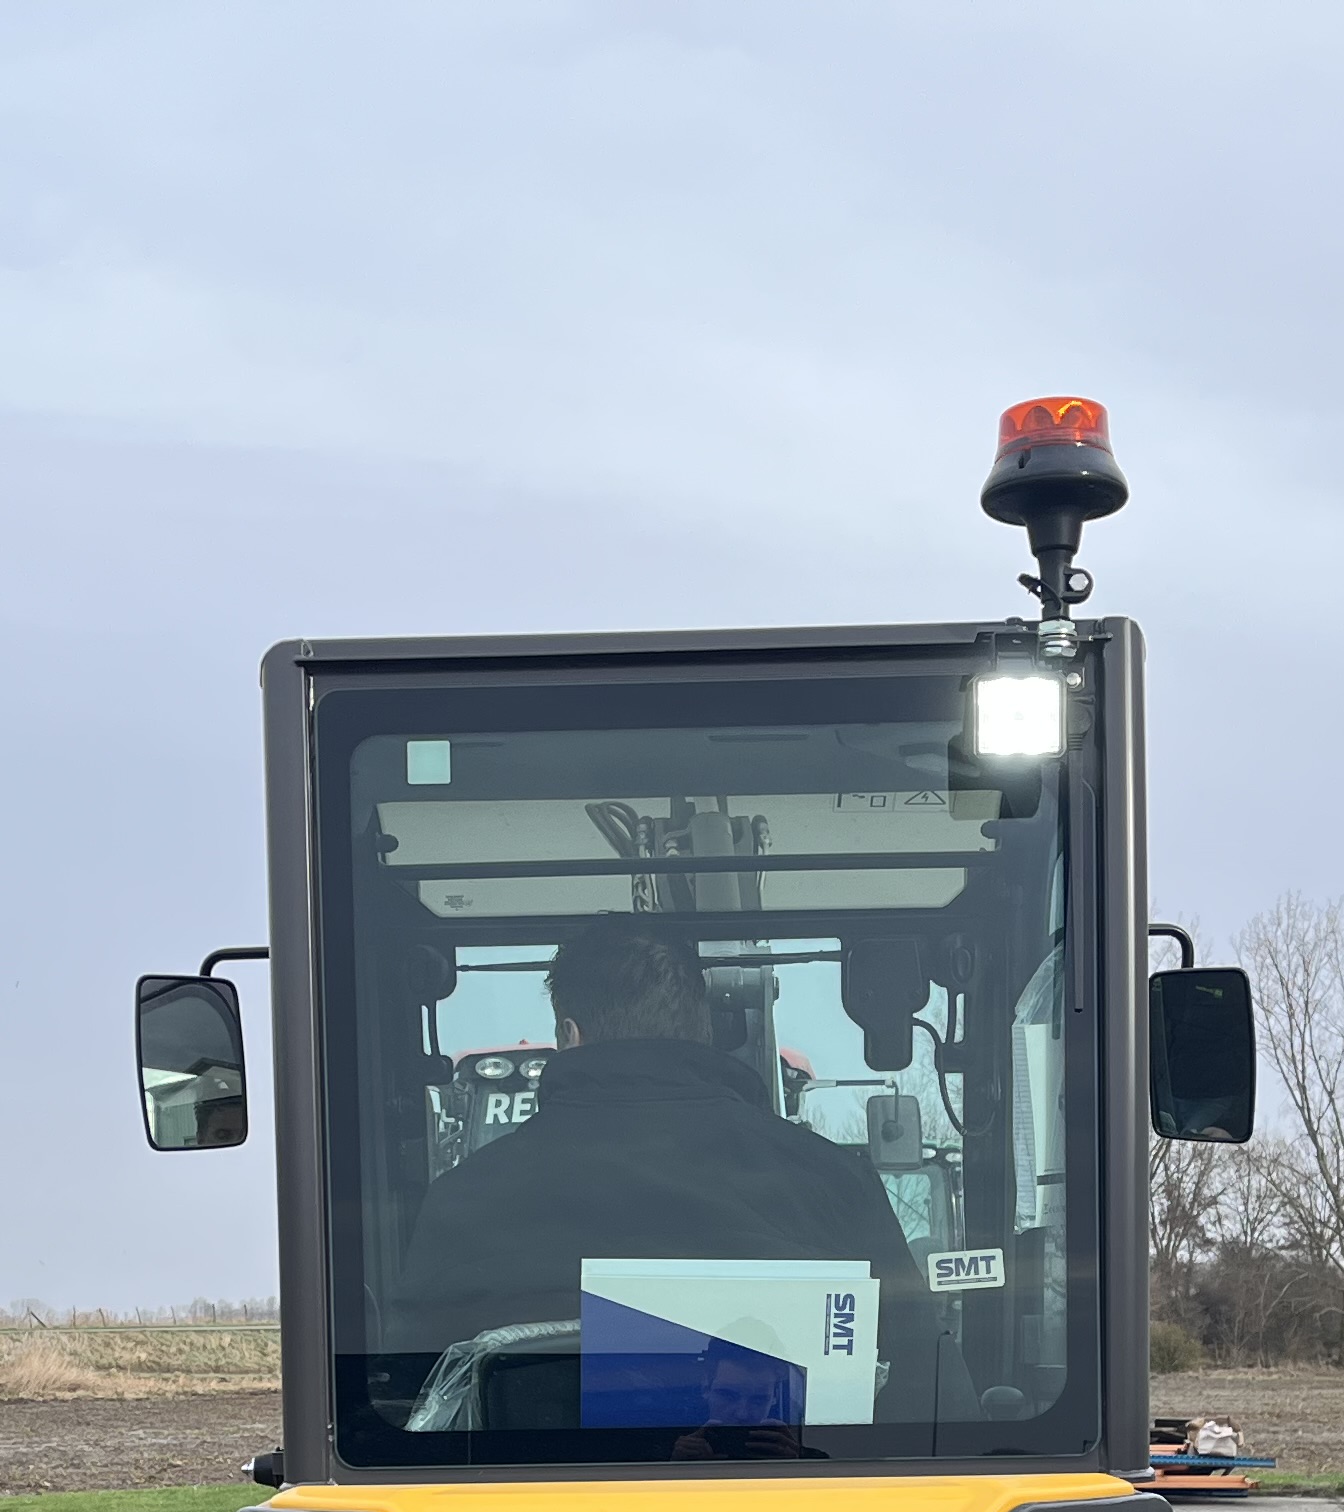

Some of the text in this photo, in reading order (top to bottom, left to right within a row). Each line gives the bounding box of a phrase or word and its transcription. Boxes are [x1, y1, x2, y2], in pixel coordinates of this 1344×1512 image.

[485, 1091, 539, 1125] RE
[936, 1255, 996, 1278] SMT
[832, 1293, 855, 1355] SMT
